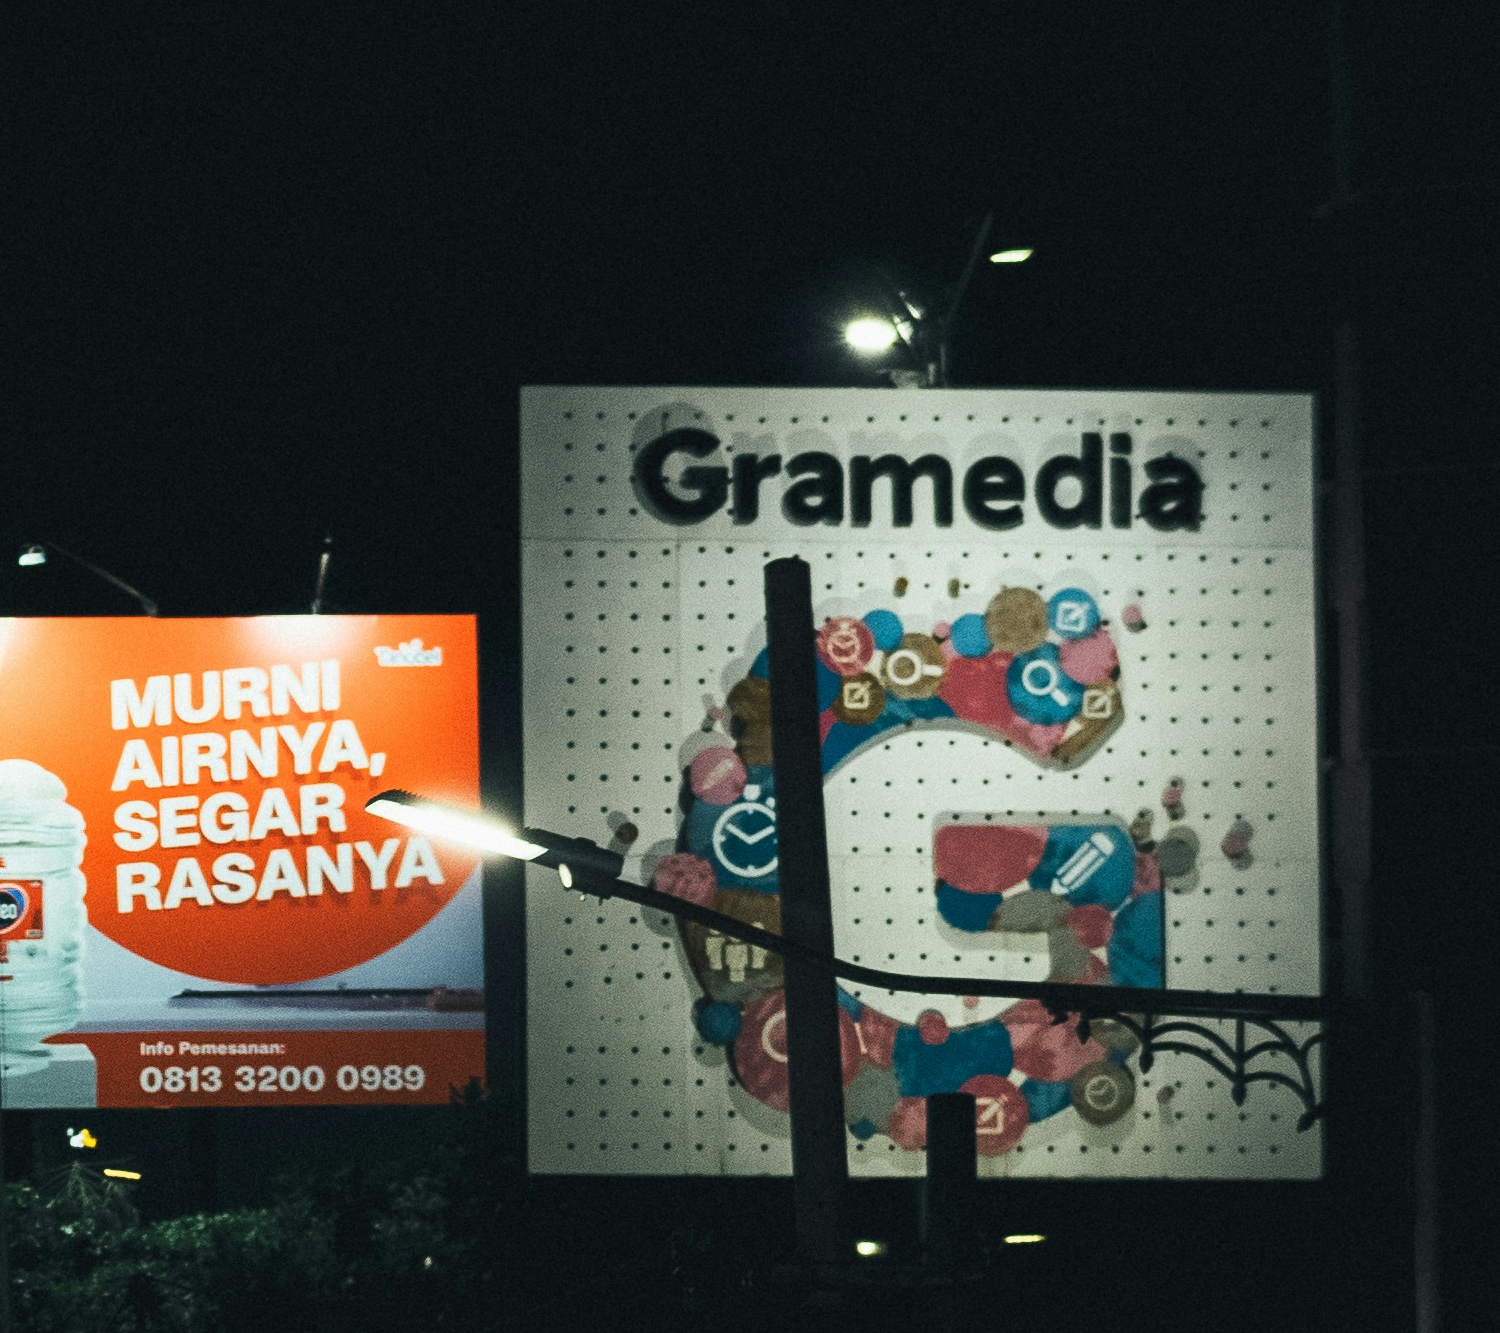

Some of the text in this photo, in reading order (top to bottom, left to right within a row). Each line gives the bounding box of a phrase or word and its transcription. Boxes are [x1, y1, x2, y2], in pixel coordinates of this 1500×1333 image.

[633, 427, 1204, 532] Gramedia
[111, 658, 341, 730] MURNI
[110, 718, 387, 792] AIRNYA,
[113, 783, 347, 852] SEGAR
[116, 836, 445, 914] RASANYA
[139, 1065, 425, 1093] 0813 3200 0989
[140, 1042, 285, 1056] Info Pemesanan:
